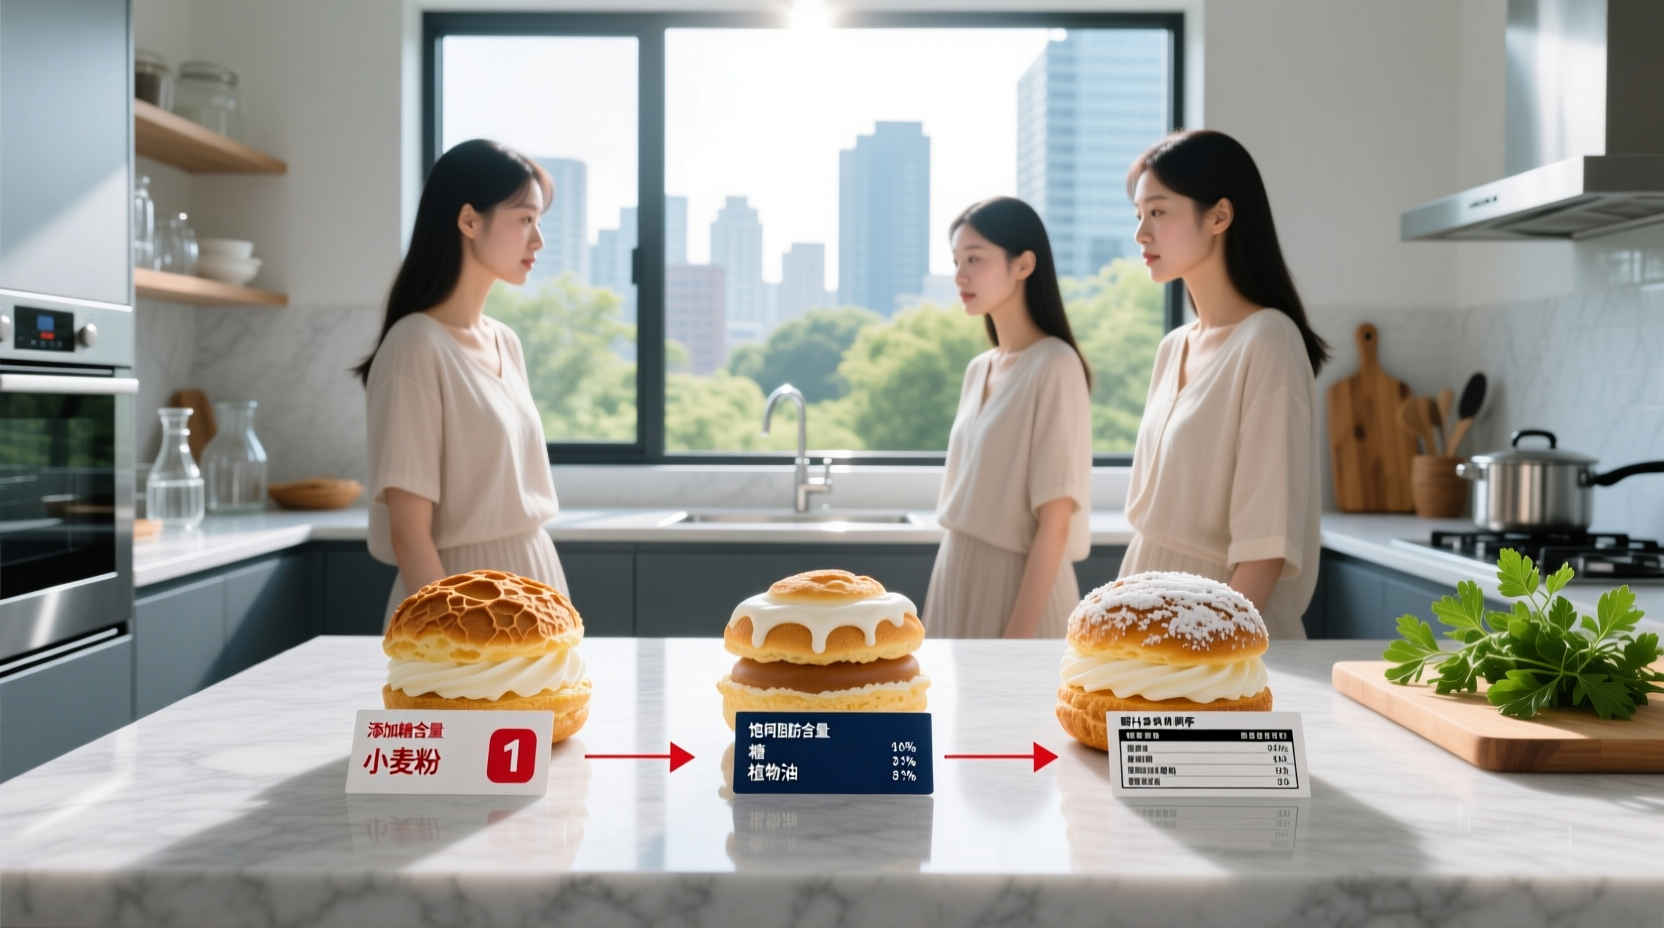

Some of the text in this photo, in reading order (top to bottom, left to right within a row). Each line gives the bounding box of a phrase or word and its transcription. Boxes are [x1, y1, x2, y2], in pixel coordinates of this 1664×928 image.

[363, 747, 441, 775] 小麦粉
[504, 738, 520, 773] 1
[747, 762, 798, 782] 植物油
